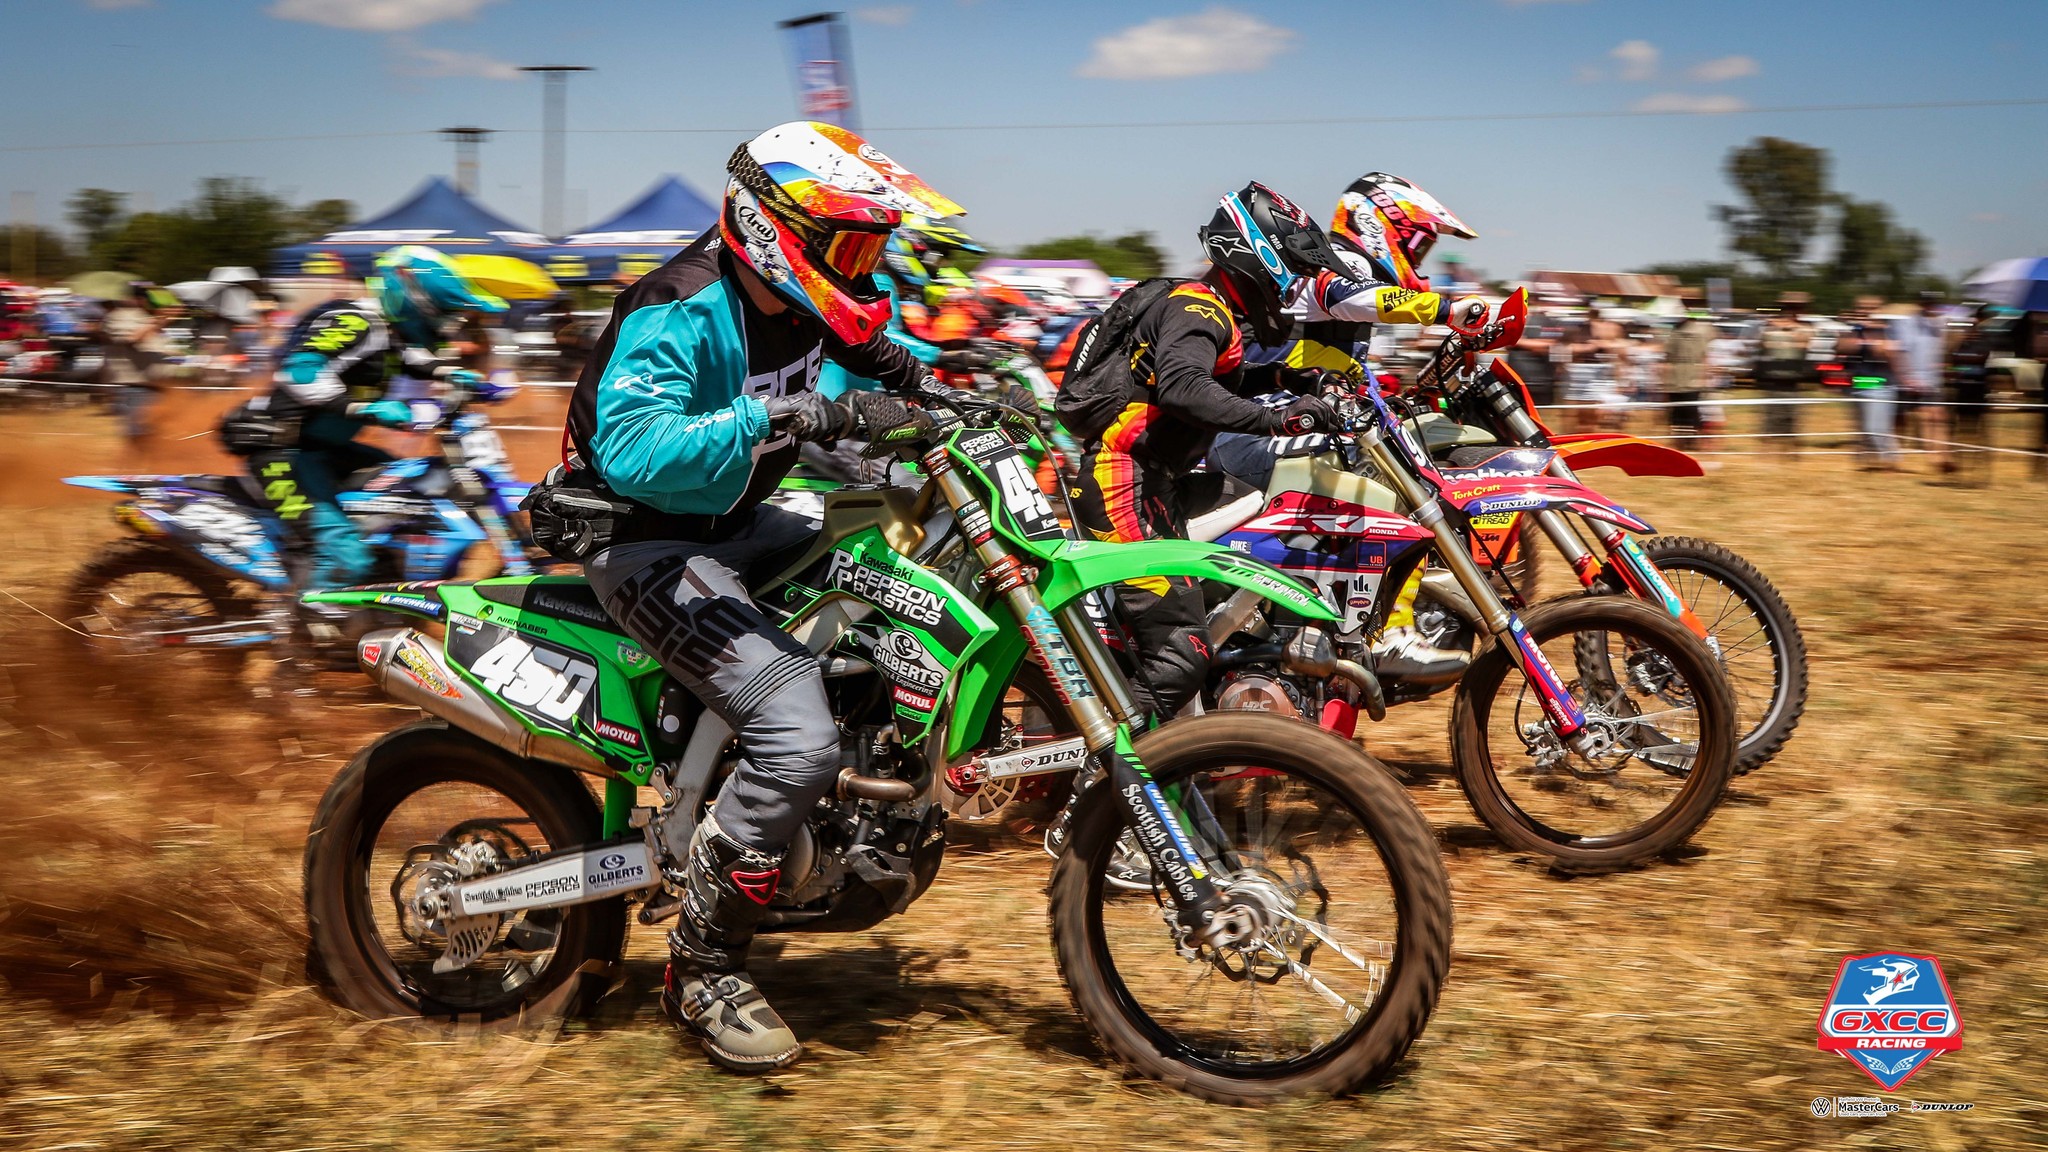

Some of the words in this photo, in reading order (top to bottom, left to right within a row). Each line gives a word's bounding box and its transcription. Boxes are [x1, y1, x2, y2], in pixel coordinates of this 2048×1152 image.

[740, 211, 774, 238] Arai
[960, 431, 999, 450] PEPSON
[966, 438, 1004, 456] PLASTICS
[1489, 498, 1543, 510] DUNLOP
[1586, 506, 1618, 522] MOTUL
[1369, 528, 1399, 536] HONDA
[859, 551, 913, 581] Kawasaki
[853, 567, 948, 610] PEPSON
[392, 596, 437, 611] MICHELIN
[534, 590, 607, 622] Kawasaki
[853, 583, 942, 626] PLASTICS
[497, 615, 548, 636] NIENABER
[873, 644, 944, 687] GILBERTS
[470, 636, 597, 721] 450
[895, 675, 934, 696] Engineering
[895, 689, 931, 709] MOTUL
[598, 723, 637, 744] MOTUL
[1122, 783, 1167, 851] Scottish
[1159, 847, 1198, 901] Cables
[525, 874, 579, 891] PEPSON
[588, 865, 644, 885] GILBERTS
[526, 882, 581, 899] PLASTICS
